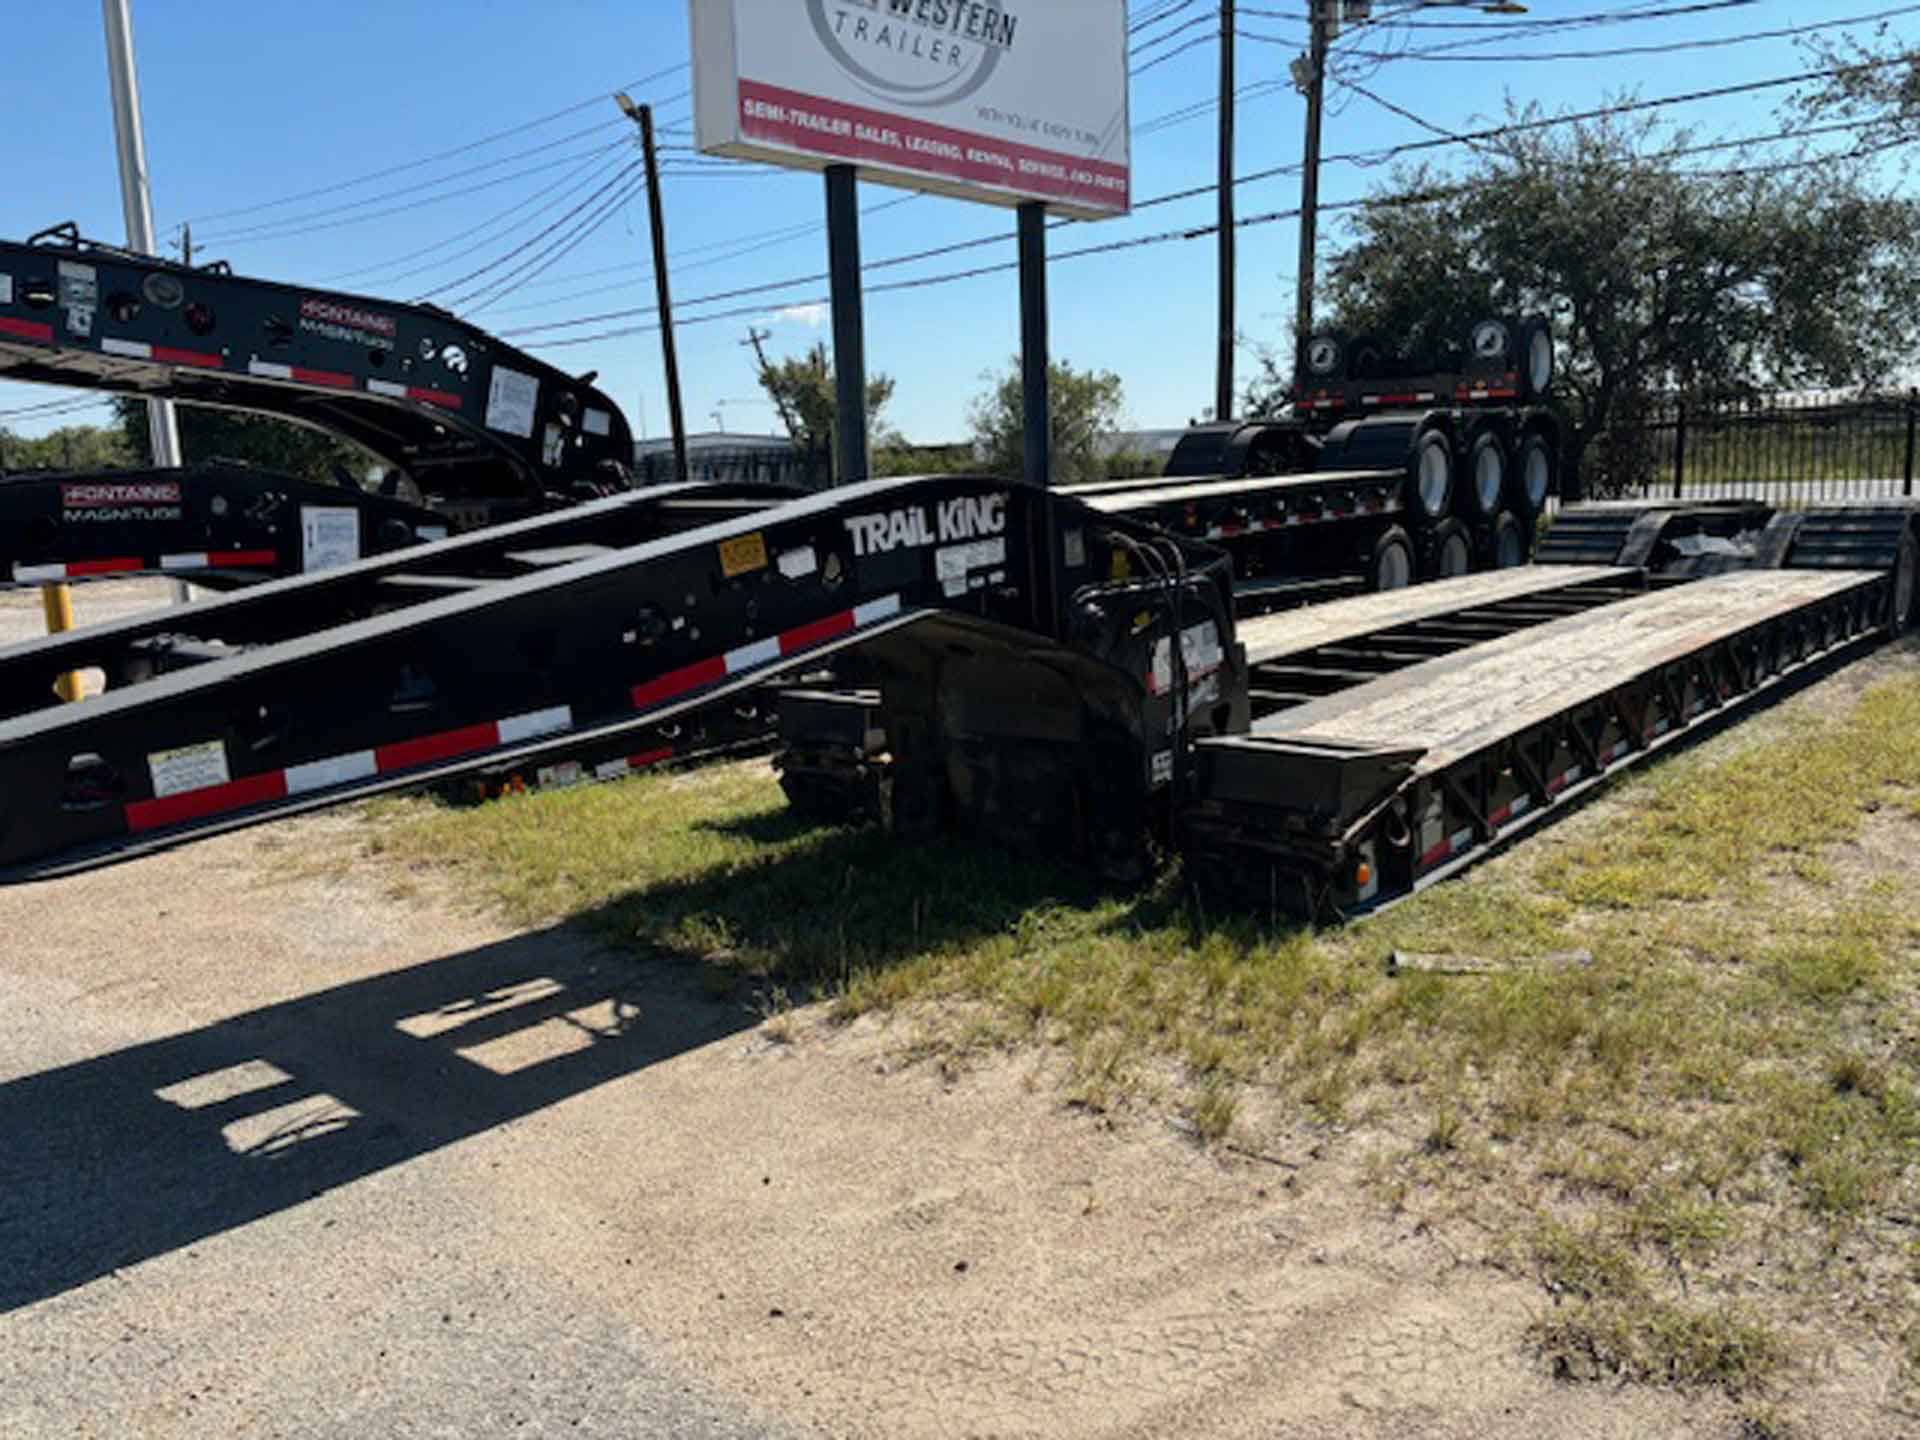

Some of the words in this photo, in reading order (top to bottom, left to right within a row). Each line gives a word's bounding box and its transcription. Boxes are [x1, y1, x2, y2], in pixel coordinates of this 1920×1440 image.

[835, 10, 961, 67] TRAILER
[744, 99, 852, 136] SEMI-TRAILER
[63, 506, 180, 521] MAGNITUDE
